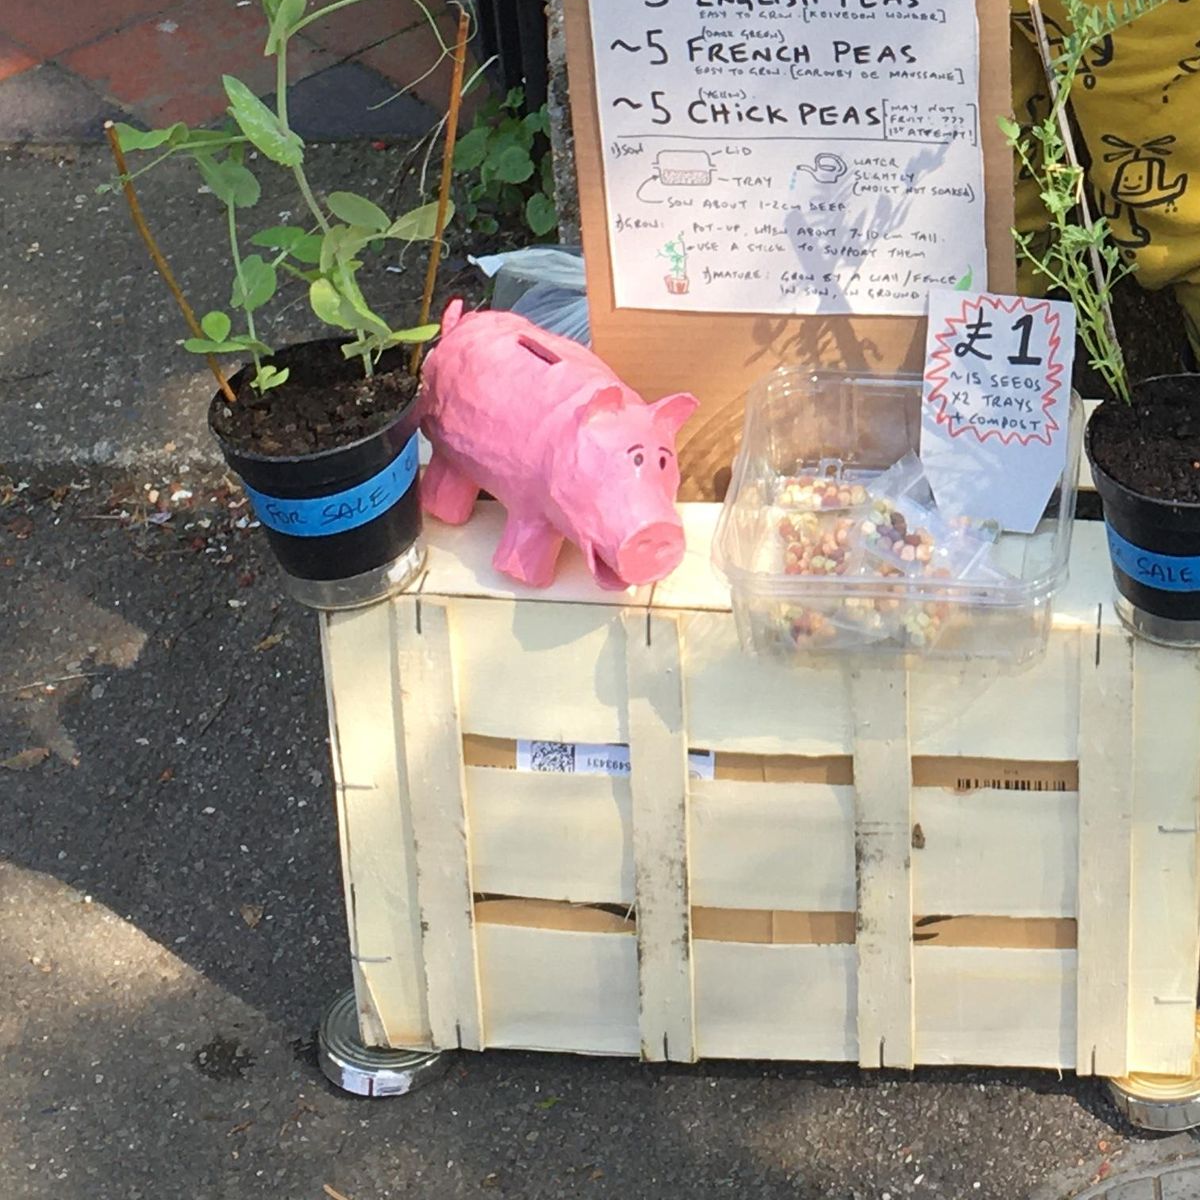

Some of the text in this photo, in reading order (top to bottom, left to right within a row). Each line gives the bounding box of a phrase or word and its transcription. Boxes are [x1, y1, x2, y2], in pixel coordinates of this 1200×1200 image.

[736, 11, 751, 19] TO
[687, 36, 810, 64] FRENCH
[832, 40, 917, 64] PEAS
[728, 67, 744, 76] TO
[798, 102, 881, 126] PEAS
[732, 176, 773, 188] TRAY
[667, 196, 694, 208] SOW
[702, 199, 748, 210] ABOUT
[797, 227, 837, 237] ABOUT
[697, 243, 719, 252] USE
[730, 243, 740, 252] A
[797, 243, 814, 252] TO
[824, 245, 878, 258] SUPPORT
[990, 374, 1042, 392] SEEDS
[982, 394, 1033, 413] TRAYS
[969, 414, 1042, 432] COMPOST
